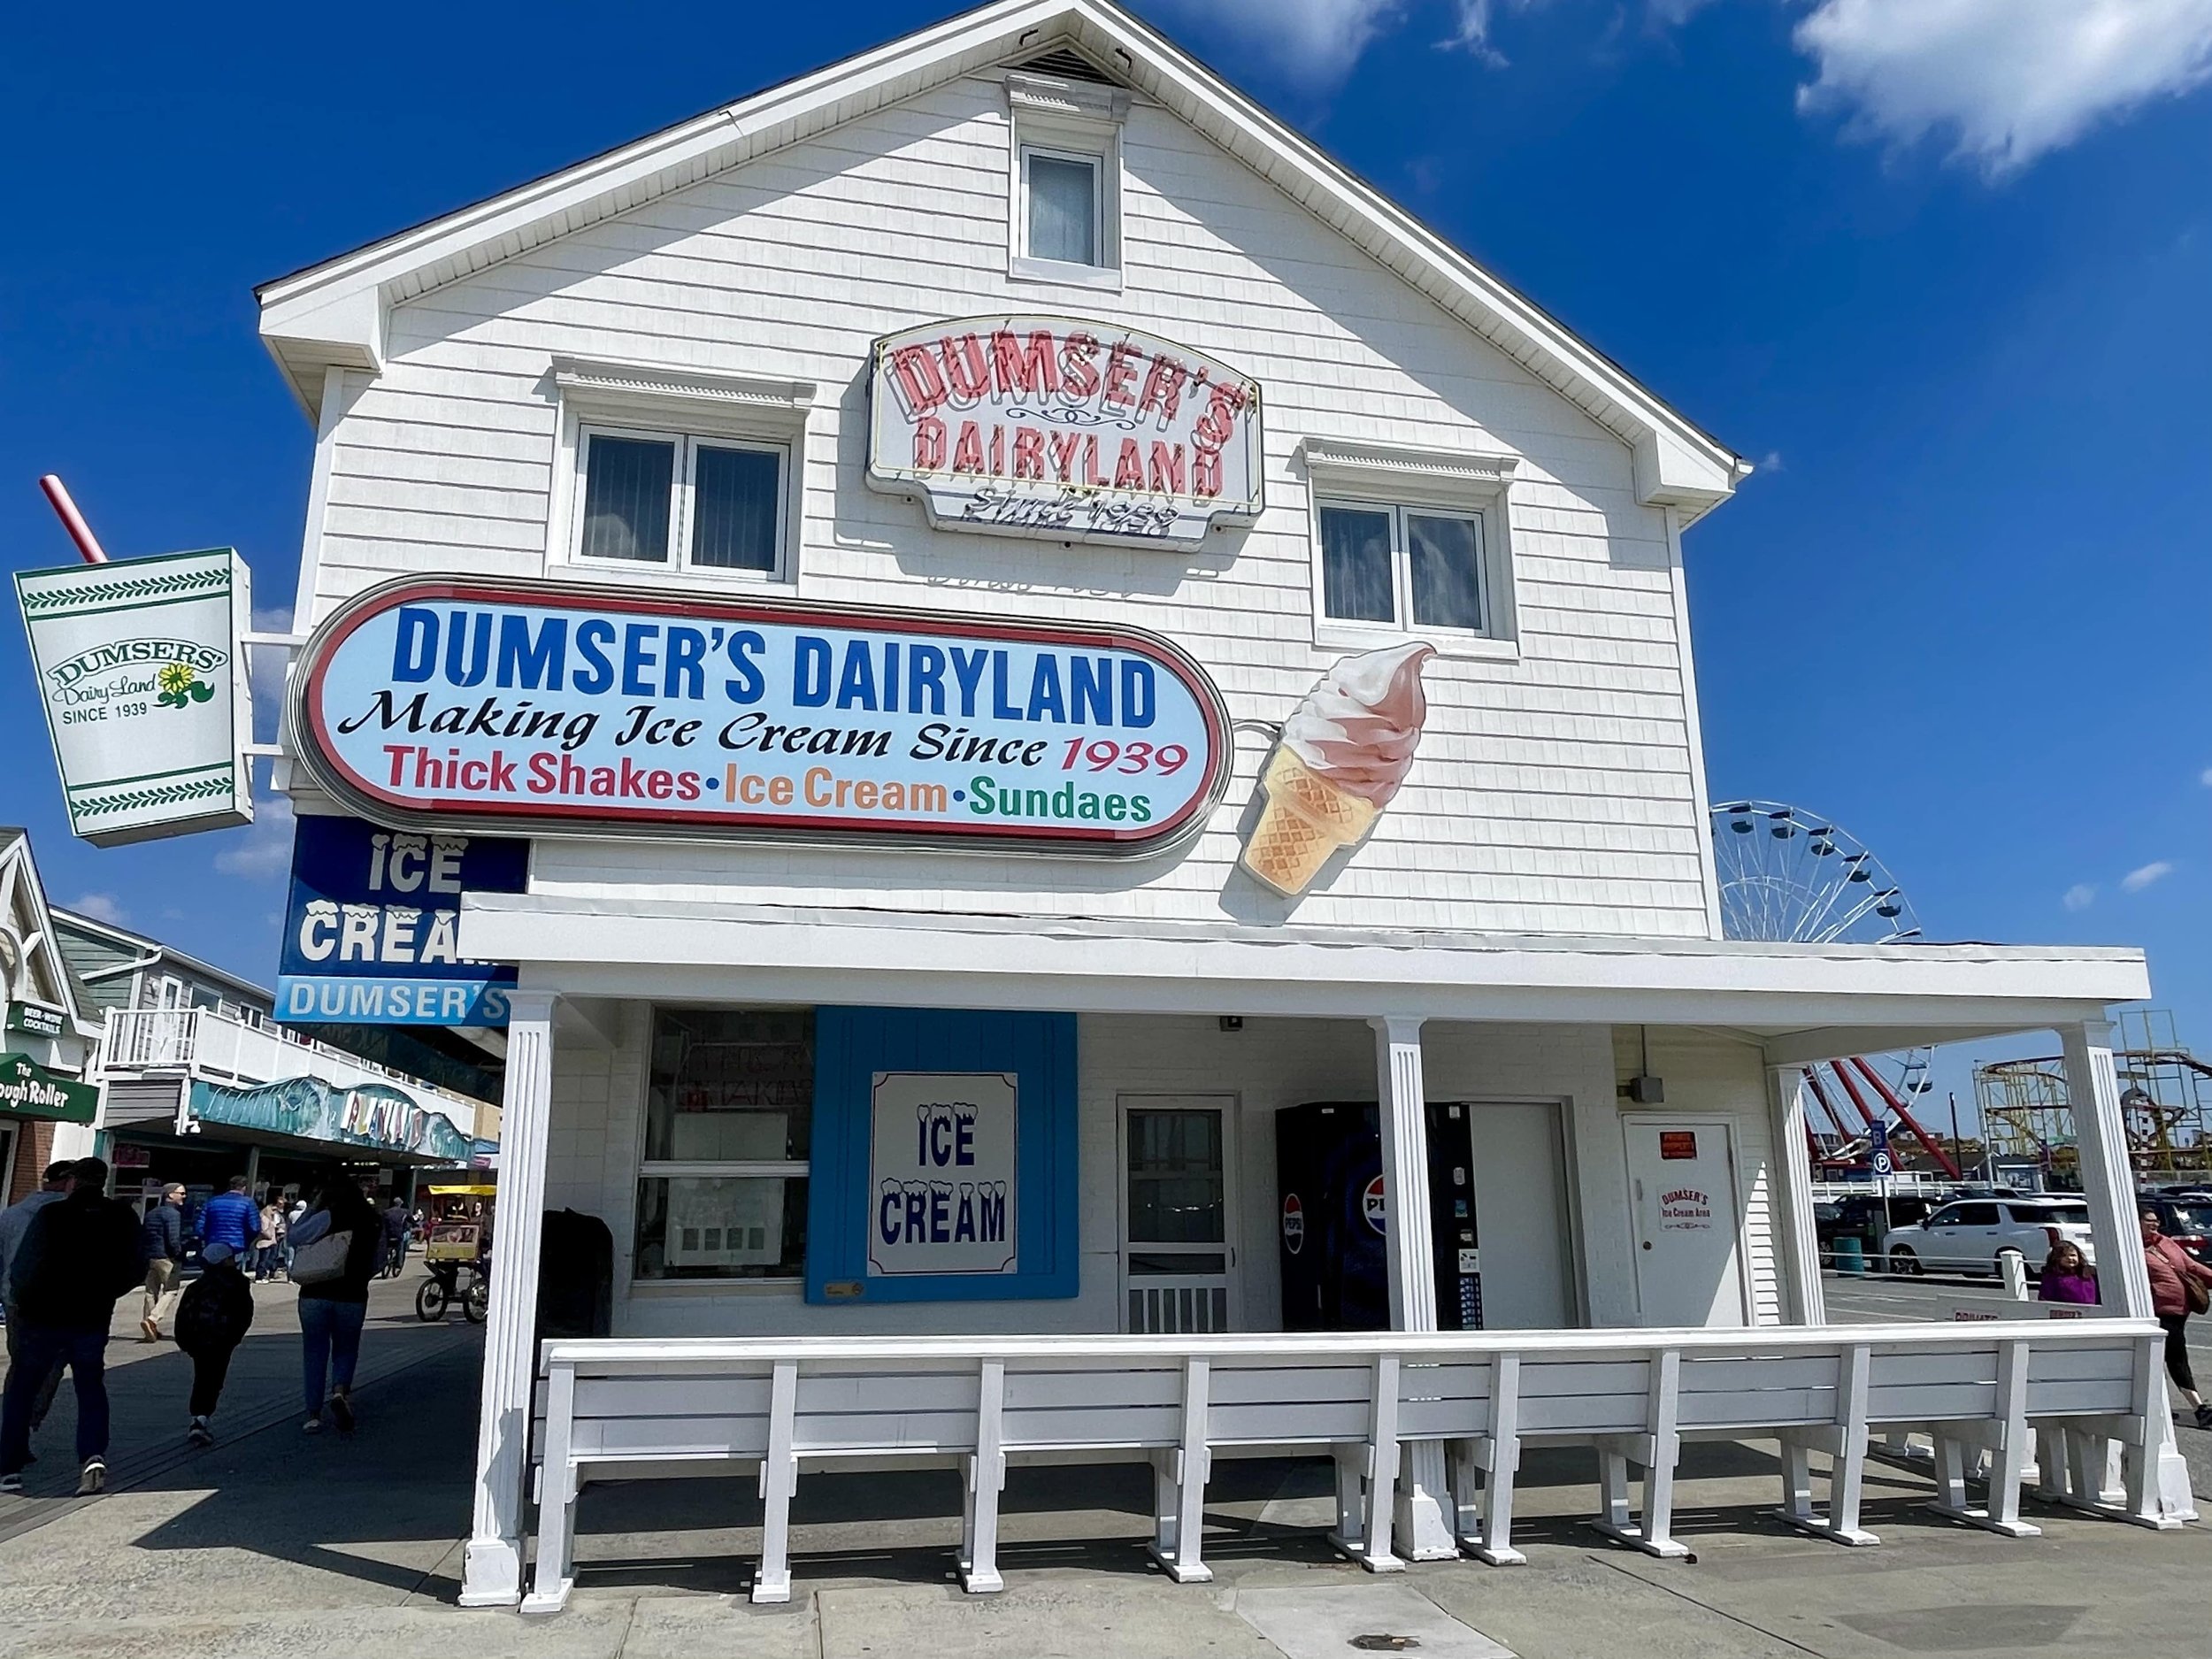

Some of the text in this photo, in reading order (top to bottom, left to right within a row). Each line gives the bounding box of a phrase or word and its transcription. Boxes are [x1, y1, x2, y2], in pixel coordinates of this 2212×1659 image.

[886, 330, 1248, 453] DUMSER'S
[912, 416, 1225, 507] DAIRYLAND
[51, 672, 157, 706] Dairy Land
[53, 641, 223, 687] DUMSERS'
[392, 606, 1156, 729] DUMSER'S DAIRYLAND
[62, 702, 147, 726] SINCE 1939
[337, 690, 1189, 777] Making Ice Cream Since 1939
[383, 744, 1153, 822] Thick Shakes Ice Cream Sundaes
[368, 833, 469, 894] ICE
[299, 899, 499, 966] CREA
[288, 982, 508, 1019] DUMSER'S
[16, 1061, 32, 1078] The
[28, 1079, 70, 1109] Roller
[917, 1102, 979, 1168] ICE
[1878, 1156, 1887, 1170] P
[879, 1177, 1008, 1246] CREAM
[1673, 1206, 1694, 1218] Cream
